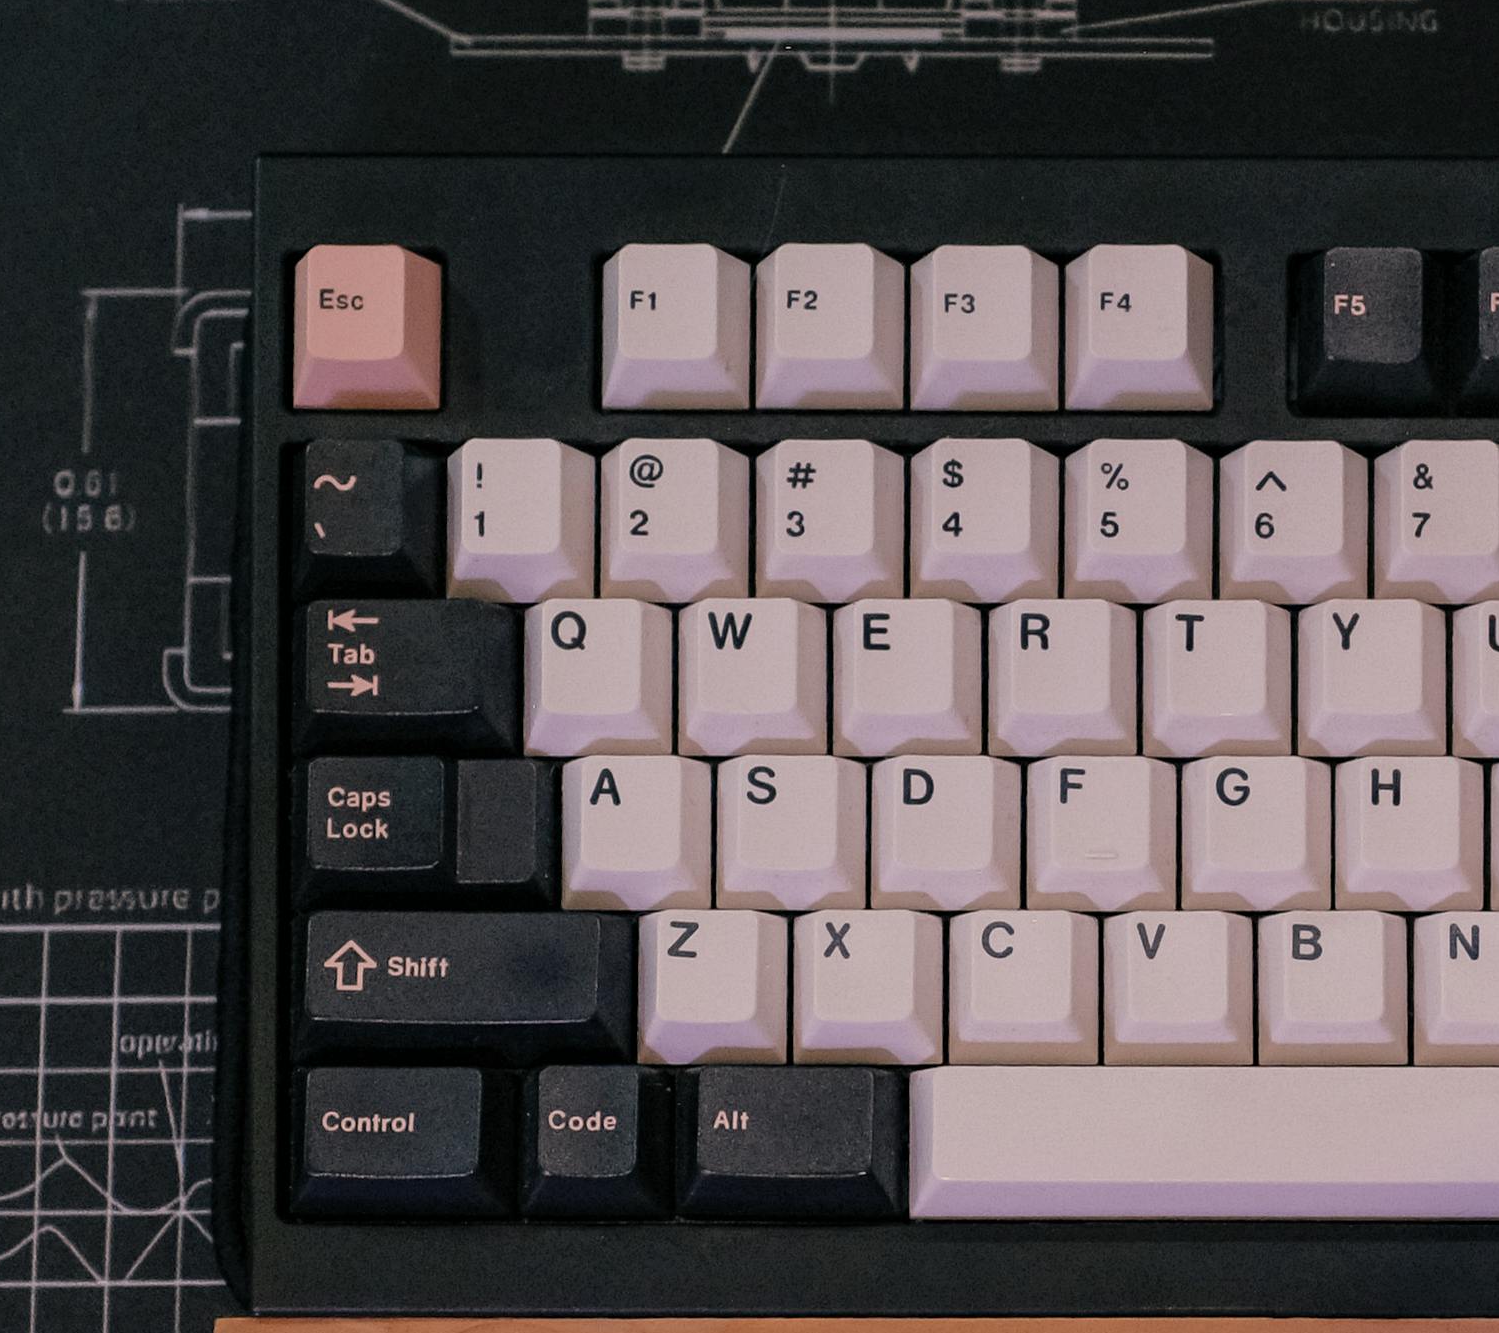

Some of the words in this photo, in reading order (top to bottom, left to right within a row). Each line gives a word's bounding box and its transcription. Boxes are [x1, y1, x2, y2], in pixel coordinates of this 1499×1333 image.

[318, 287, 364, 311] Esc
[629, 289, 657, 311] F1
[786, 289, 818, 311] F2
[943, 292, 976, 315] F3
[1099, 291, 1132, 313] F4
[1334, 294, 1367, 316] F5
[474, 510, 486, 537] 1
[629, 509, 649, 537] 2
[785, 510, 806, 538] 3
[941, 511, 963, 537] 4
[1100, 511, 1120, 539] 5
[1254, 512, 1275, 540] 6
[1412, 511, 1431, 538] 7
[550, 610, 587, 651] Q
[707, 611, 753, 650] W
[862, 613, 891, 651] E
[1020, 612, 1051, 651] R
[1175, 613, 1205, 652] T
[1332, 612, 1360, 651] Y
[327, 642, 376, 665] Tab
[327, 786, 392, 812] Caps
[589, 768, 622, 806] A
[746, 765, 777, 805] S
[902, 768, 935, 806] D
[1059, 767, 1086, 805] F
[1215, 767, 1251, 807] G
[1371, 768, 1402, 807] H
[326, 817, 389, 839] Lock
[53, 884, 191, 915] pressure
[666, 920, 700, 959] Z
[823, 921, 851, 960] X
[981, 921, 1015, 960] C
[1136, 922, 1166, 960] V
[1291, 923, 1323, 961] B
[1449, 923, 1480, 961] N
[387, 955, 449, 978] Shift
[321, 1110, 415, 1133] Control
[548, 1109, 617, 1132] Code
[713, 1110, 749, 1130] Alt
